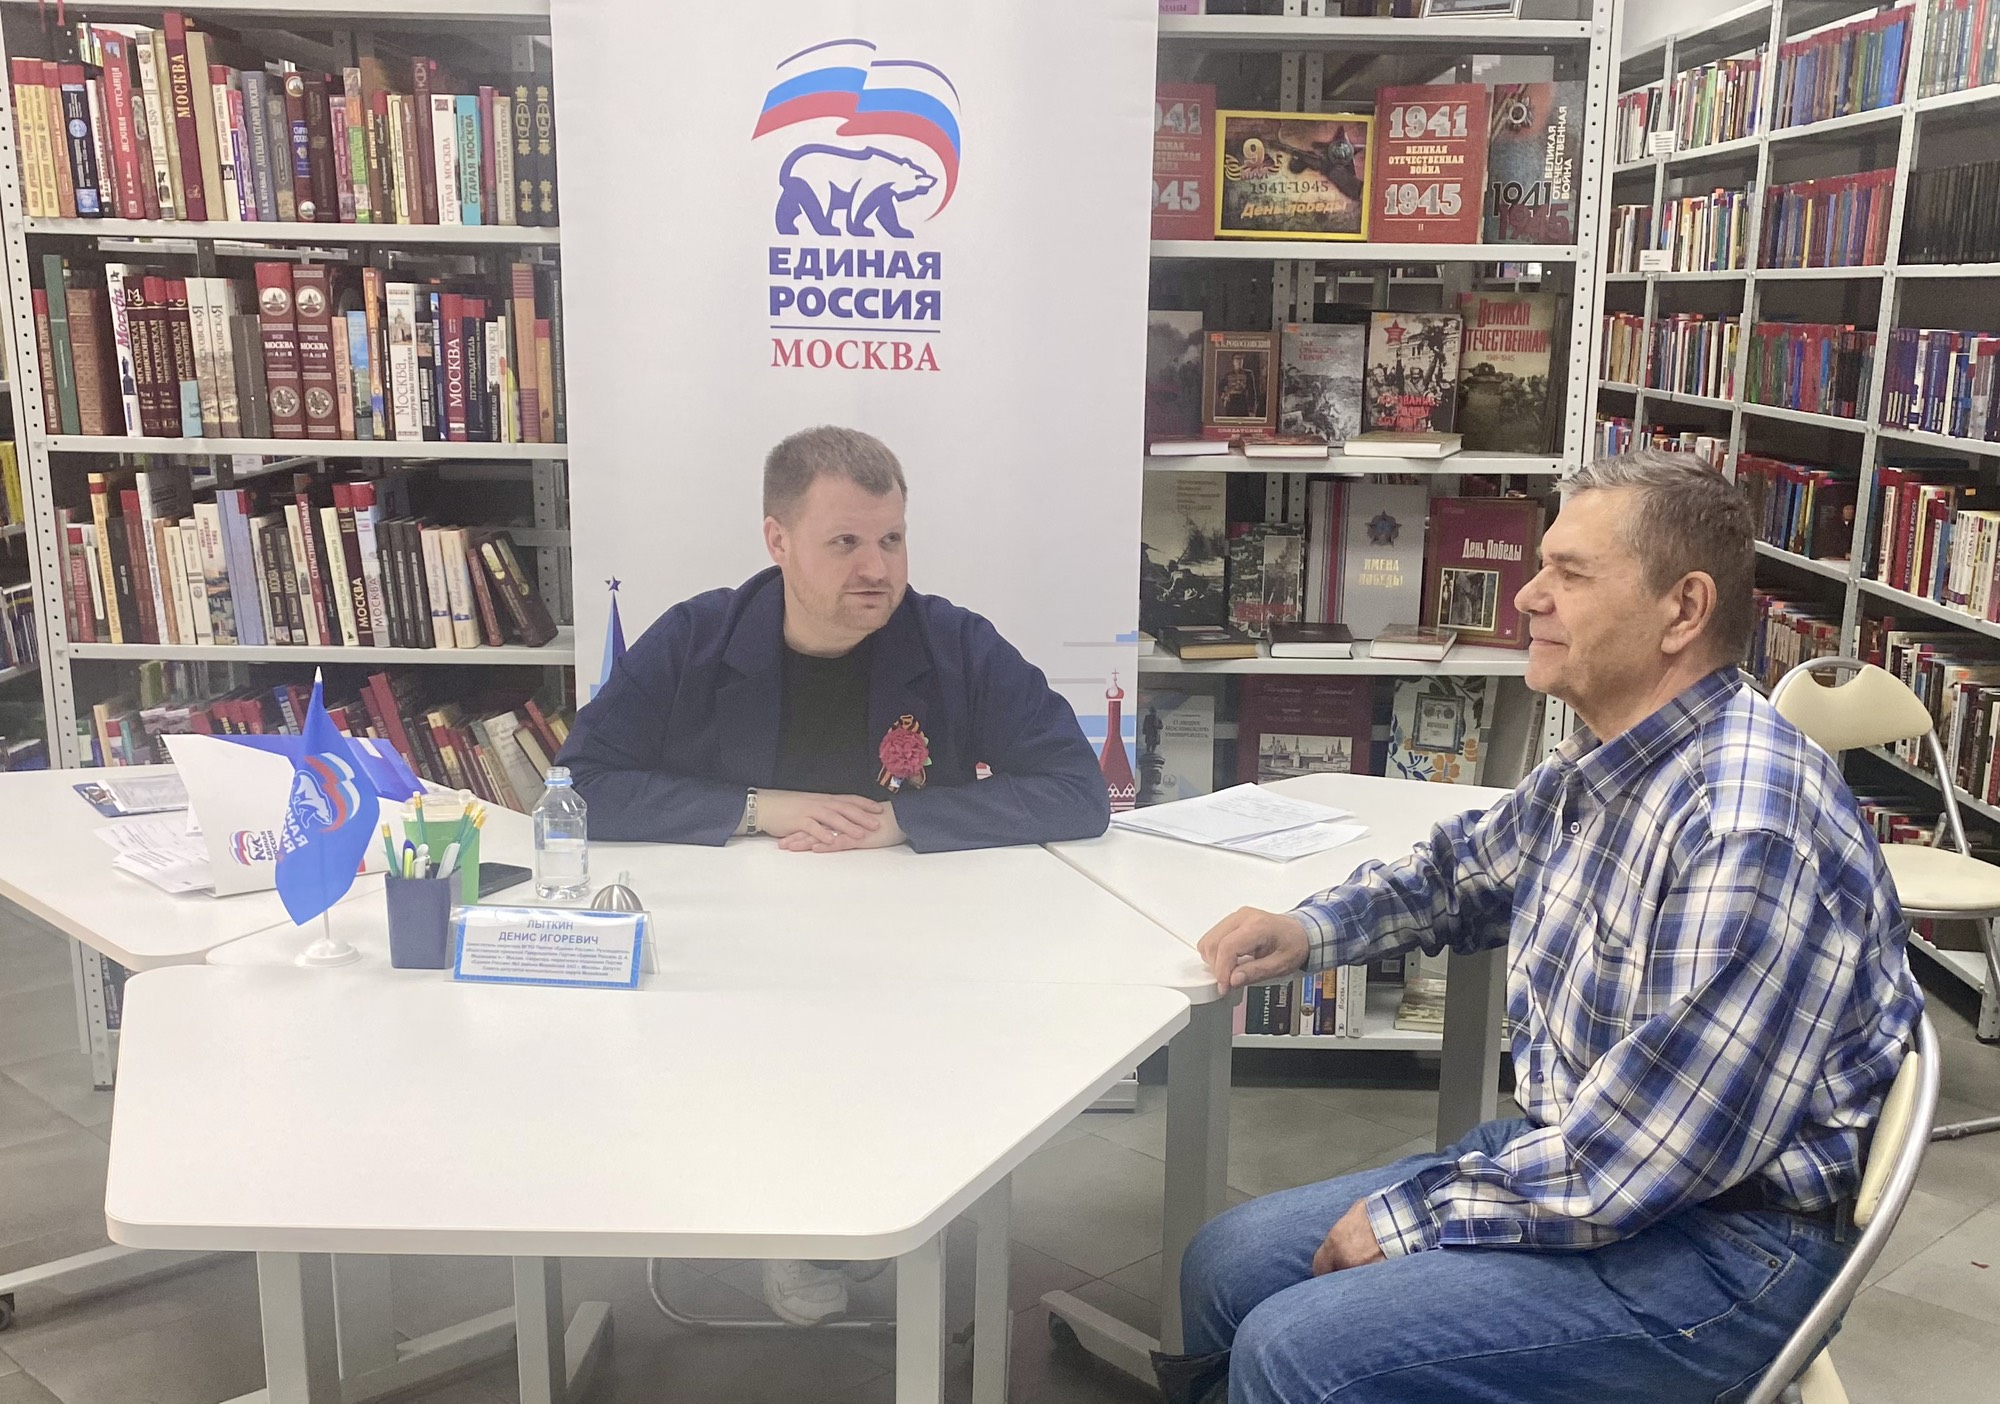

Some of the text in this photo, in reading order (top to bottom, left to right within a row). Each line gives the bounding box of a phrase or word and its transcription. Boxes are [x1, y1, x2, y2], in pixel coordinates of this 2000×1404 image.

[171, 54, 191, 118] МОСКВА
[1389, 105, 1468, 138] 1941
[465, 114, 478, 204] СТАРАЯ МОСКВА
[1243, 138, 1265, 165] 9
[1388, 155, 1464, 164] ОТЕЧЕСТВЕННАЯ
[1406, 145, 1448, 155] ВЕЛИКАЯ
[1544, 125, 1557, 179] ВЕЛИКАЯ
[1552, 106, 1568, 200] ОТЕЧЕСТВЕННАЯ
[442, 137, 454, 222] СТАРАЯ МОСКВА
[1410, 165, 1440, 175] ВОЙНА
[1561, 158, 1573, 200] ВОЙНА
[1250, 181, 1329, 194] 1941-1945
[1384, 183, 1462, 215] 1945
[1491, 181, 1552, 218] 1941
[1240, 202, 1284, 219] День
[769, 247, 941, 280] ЕДИНАЯ
[111, 288, 130, 350] Москва
[770, 286, 941, 320] РОССИЯ
[130, 320, 145, 384] МОСКОВСКАЯ
[150, 320, 164, 383] МОСКОВСКАЯ
[300, 342, 328, 350] МОСКВА
[771, 338, 941, 371] МОСКВА
[407, 347, 415, 381] потеряли
[448, 338, 462, 407] МОСКВА
[468, 336, 477, 400] ПУТЕВОДИТЕЛЬ
[409, 382, 414, 394] мы
[301, 501, 319, 578] СТРАСТНОЙ БУЛЬВАР
[1462, 538, 1522, 561] День Победы
[1358, 573, 1403, 588] ПОБЕДЫ
[1364, 558, 1399, 572] ИМЕНА
[352, 577, 369, 627] МОСКВА
[368, 578, 383, 627] МОСКВА
[261, 831, 274, 861] ЕДИНАЯ
[498, 932, 599, 945] ДЕНИС ИГОРЕВИЧ
[527, 919, 574, 930] ЛЫТКИН
